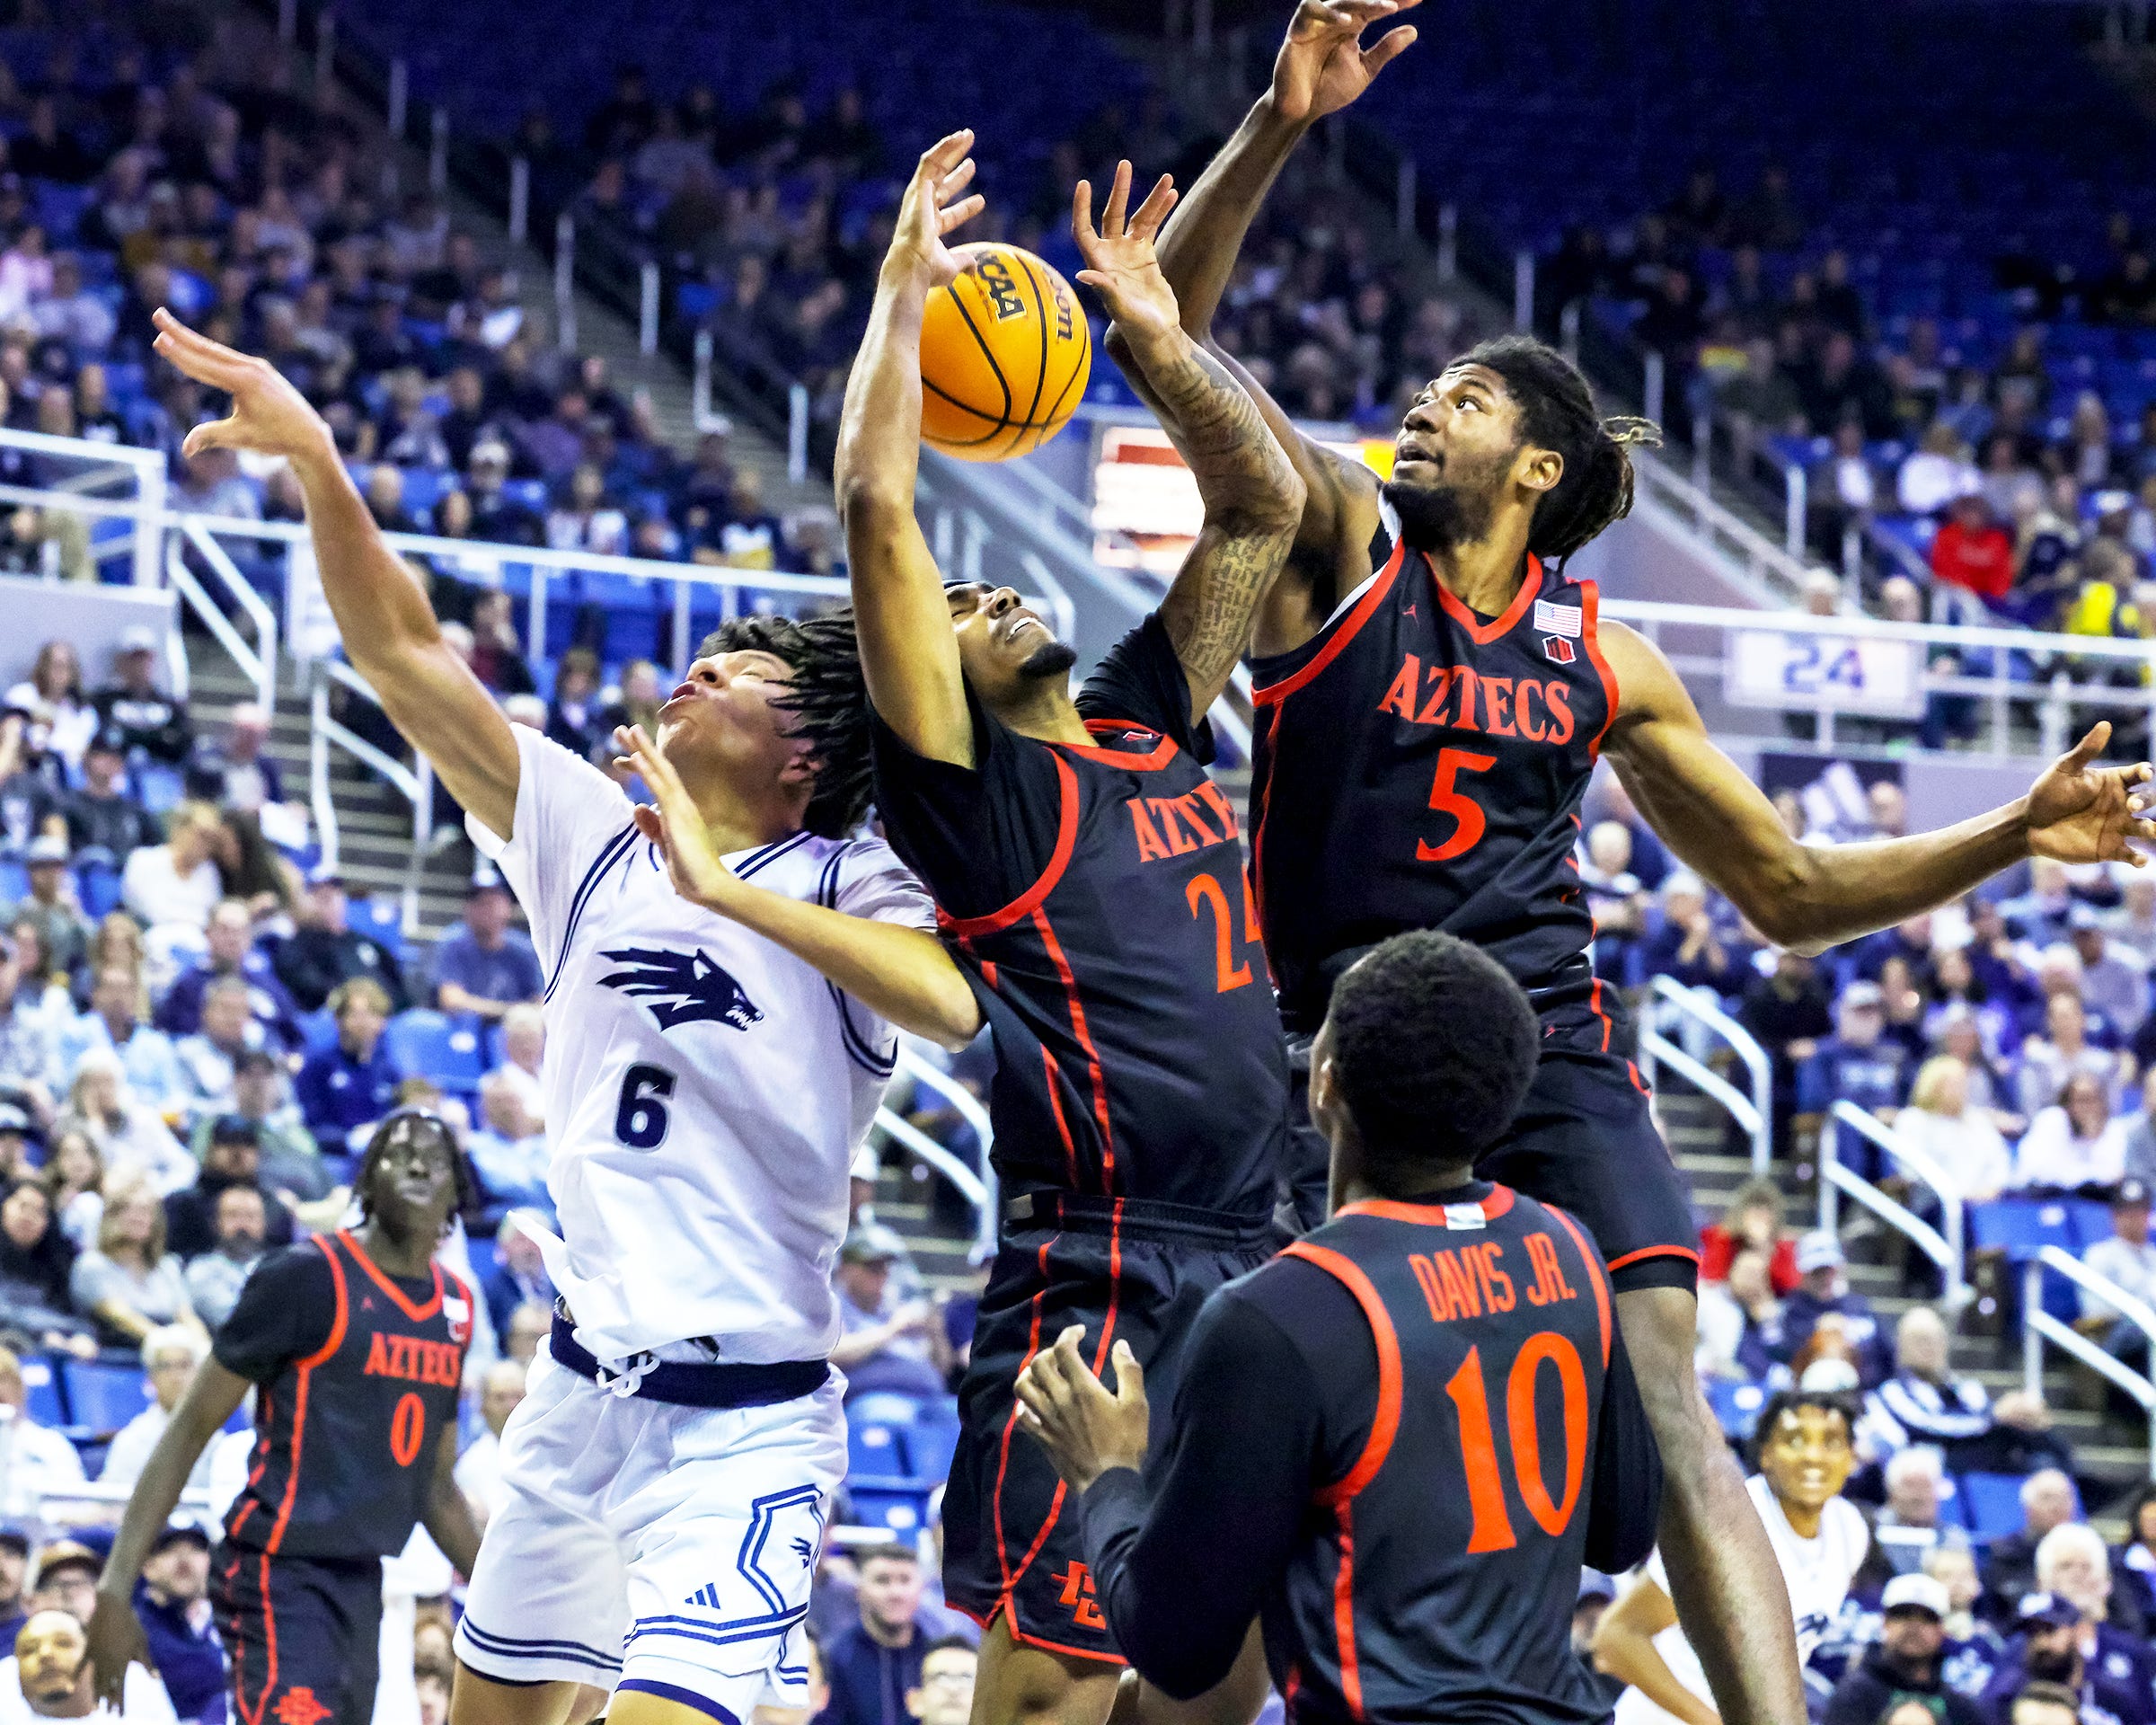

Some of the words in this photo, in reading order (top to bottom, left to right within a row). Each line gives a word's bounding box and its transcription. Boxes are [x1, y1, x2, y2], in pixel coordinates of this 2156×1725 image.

[1376, 653, 1575, 746] AZTECS
[1783, 633, 1865, 694] 24
[1126, 780, 1239, 862] AZTE
[1415, 748, 1498, 861] 5
[614, 1061, 678, 1154] 6
[1408, 1242, 1516, 1322] DAVIS
[1524, 1233, 1577, 1306] JR.
[390, 1393, 425, 1467] 0
[1445, 1331, 1588, 1554] 10
